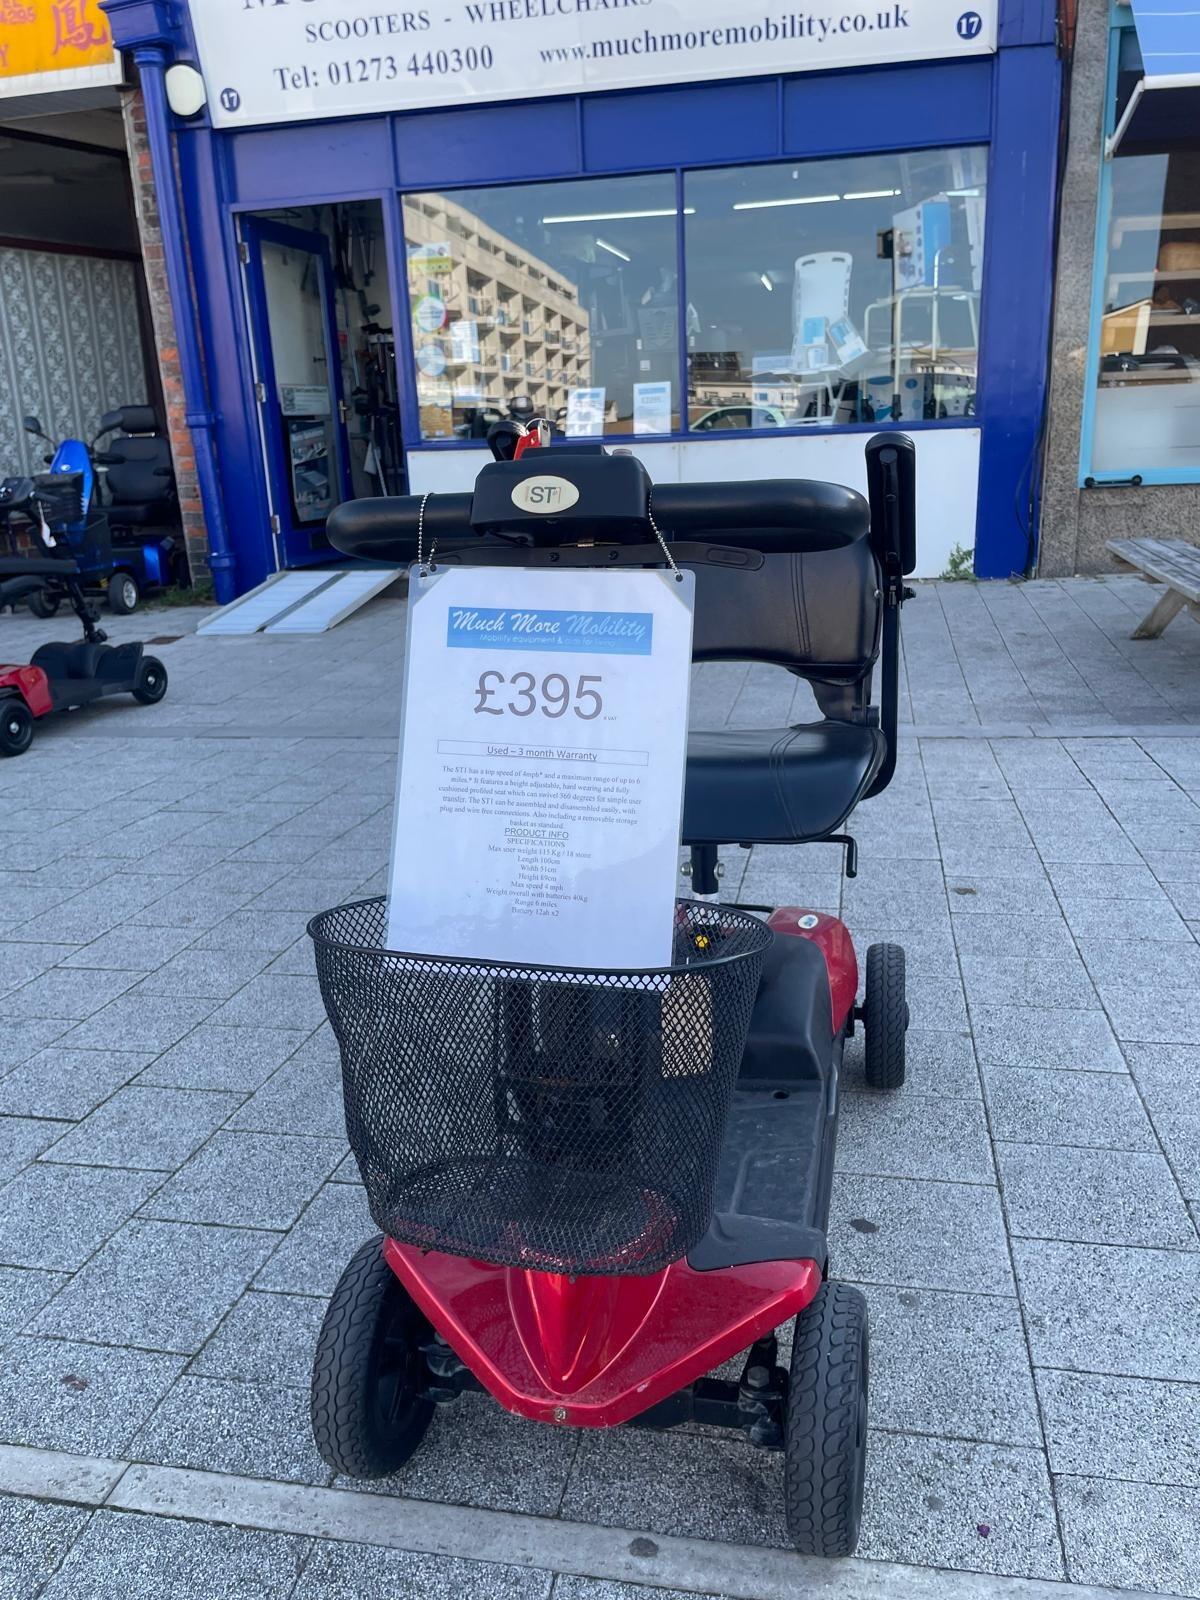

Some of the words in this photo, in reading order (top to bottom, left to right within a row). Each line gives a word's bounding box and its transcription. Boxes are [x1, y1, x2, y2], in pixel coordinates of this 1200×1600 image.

[305, 10, 431, 43] SCOOTERS
[465, 0, 650, 24] WHEELCHA
[960, 18, 981, 36] 17
[540, 5, 910, 64] www.muchmoremobility.co.uk
[274, 67, 319, 91] Tel:
[327, 54, 398, 86] 01273
[407, 45, 494, 77] 440300
[453, 610, 506, 631] Much
[511, 613, 560, 634] More
[567, 615, 646, 642] Mobility
[474, 670, 603, 720] £395
[487, 746, 509, 756] Used
[518, 747, 523, 756] 3
[525, 748, 554, 758] month
[556, 750, 598, 761] Warranty
[443, 765, 453, 773] The
[486, 769, 494, 777] top
[497, 769, 513, 778] speed
[544, 771, 555, 779] and
[562, 772, 591, 781] maximum
[594, 776, 609, 784] range
[481, 777, 503, 785] features
[510, 779, 528, 789] height
[530, 780, 561, 791] adjustable,
[563, 782, 576, 790] hard
[578, 783, 601, 793] wearing
[616, 786, 629, 795] fully
[439, 785, 468, 793] cushioned
[470, 787, 492, 796] profiled
[508, 789, 525, 797] which
[539, 791, 558, 799] swivel
[560, 792, 571, 800] 360
[572, 793, 595, 803] degrees
[607, 795, 627, 805] simple
[516, 800, 546, 808] assembled
[561, 803, 600, 812] disassembled
[440, 805, 452, 814] plug
[467, 806, 480, 814] wire
[482, 807, 492, 815] free
[548, 812, 576, 822] including
[583, 814, 614, 823] removable
[616, 817, 637, 826] storage
[510, 819, 528, 827] basket
[504, 828, 546, 838] PRODUCT
[549, 831, 568, 839] INFO
[507, 838, 566, 848] SPECIFICATIONS
[518, 856, 538, 864] Length
[520, 864, 538, 872] Width
[519, 873, 538, 881] Height
[526, 882, 543, 890] speed
[550, 884, 563, 892] mph
[486, 888, 507, 896] Weight
[546, 892, 571, 900] batteries
[573, 894, 588, 902] 40kg
[515, 899, 534, 907] Range
[512, 907, 533, 916] Battery
